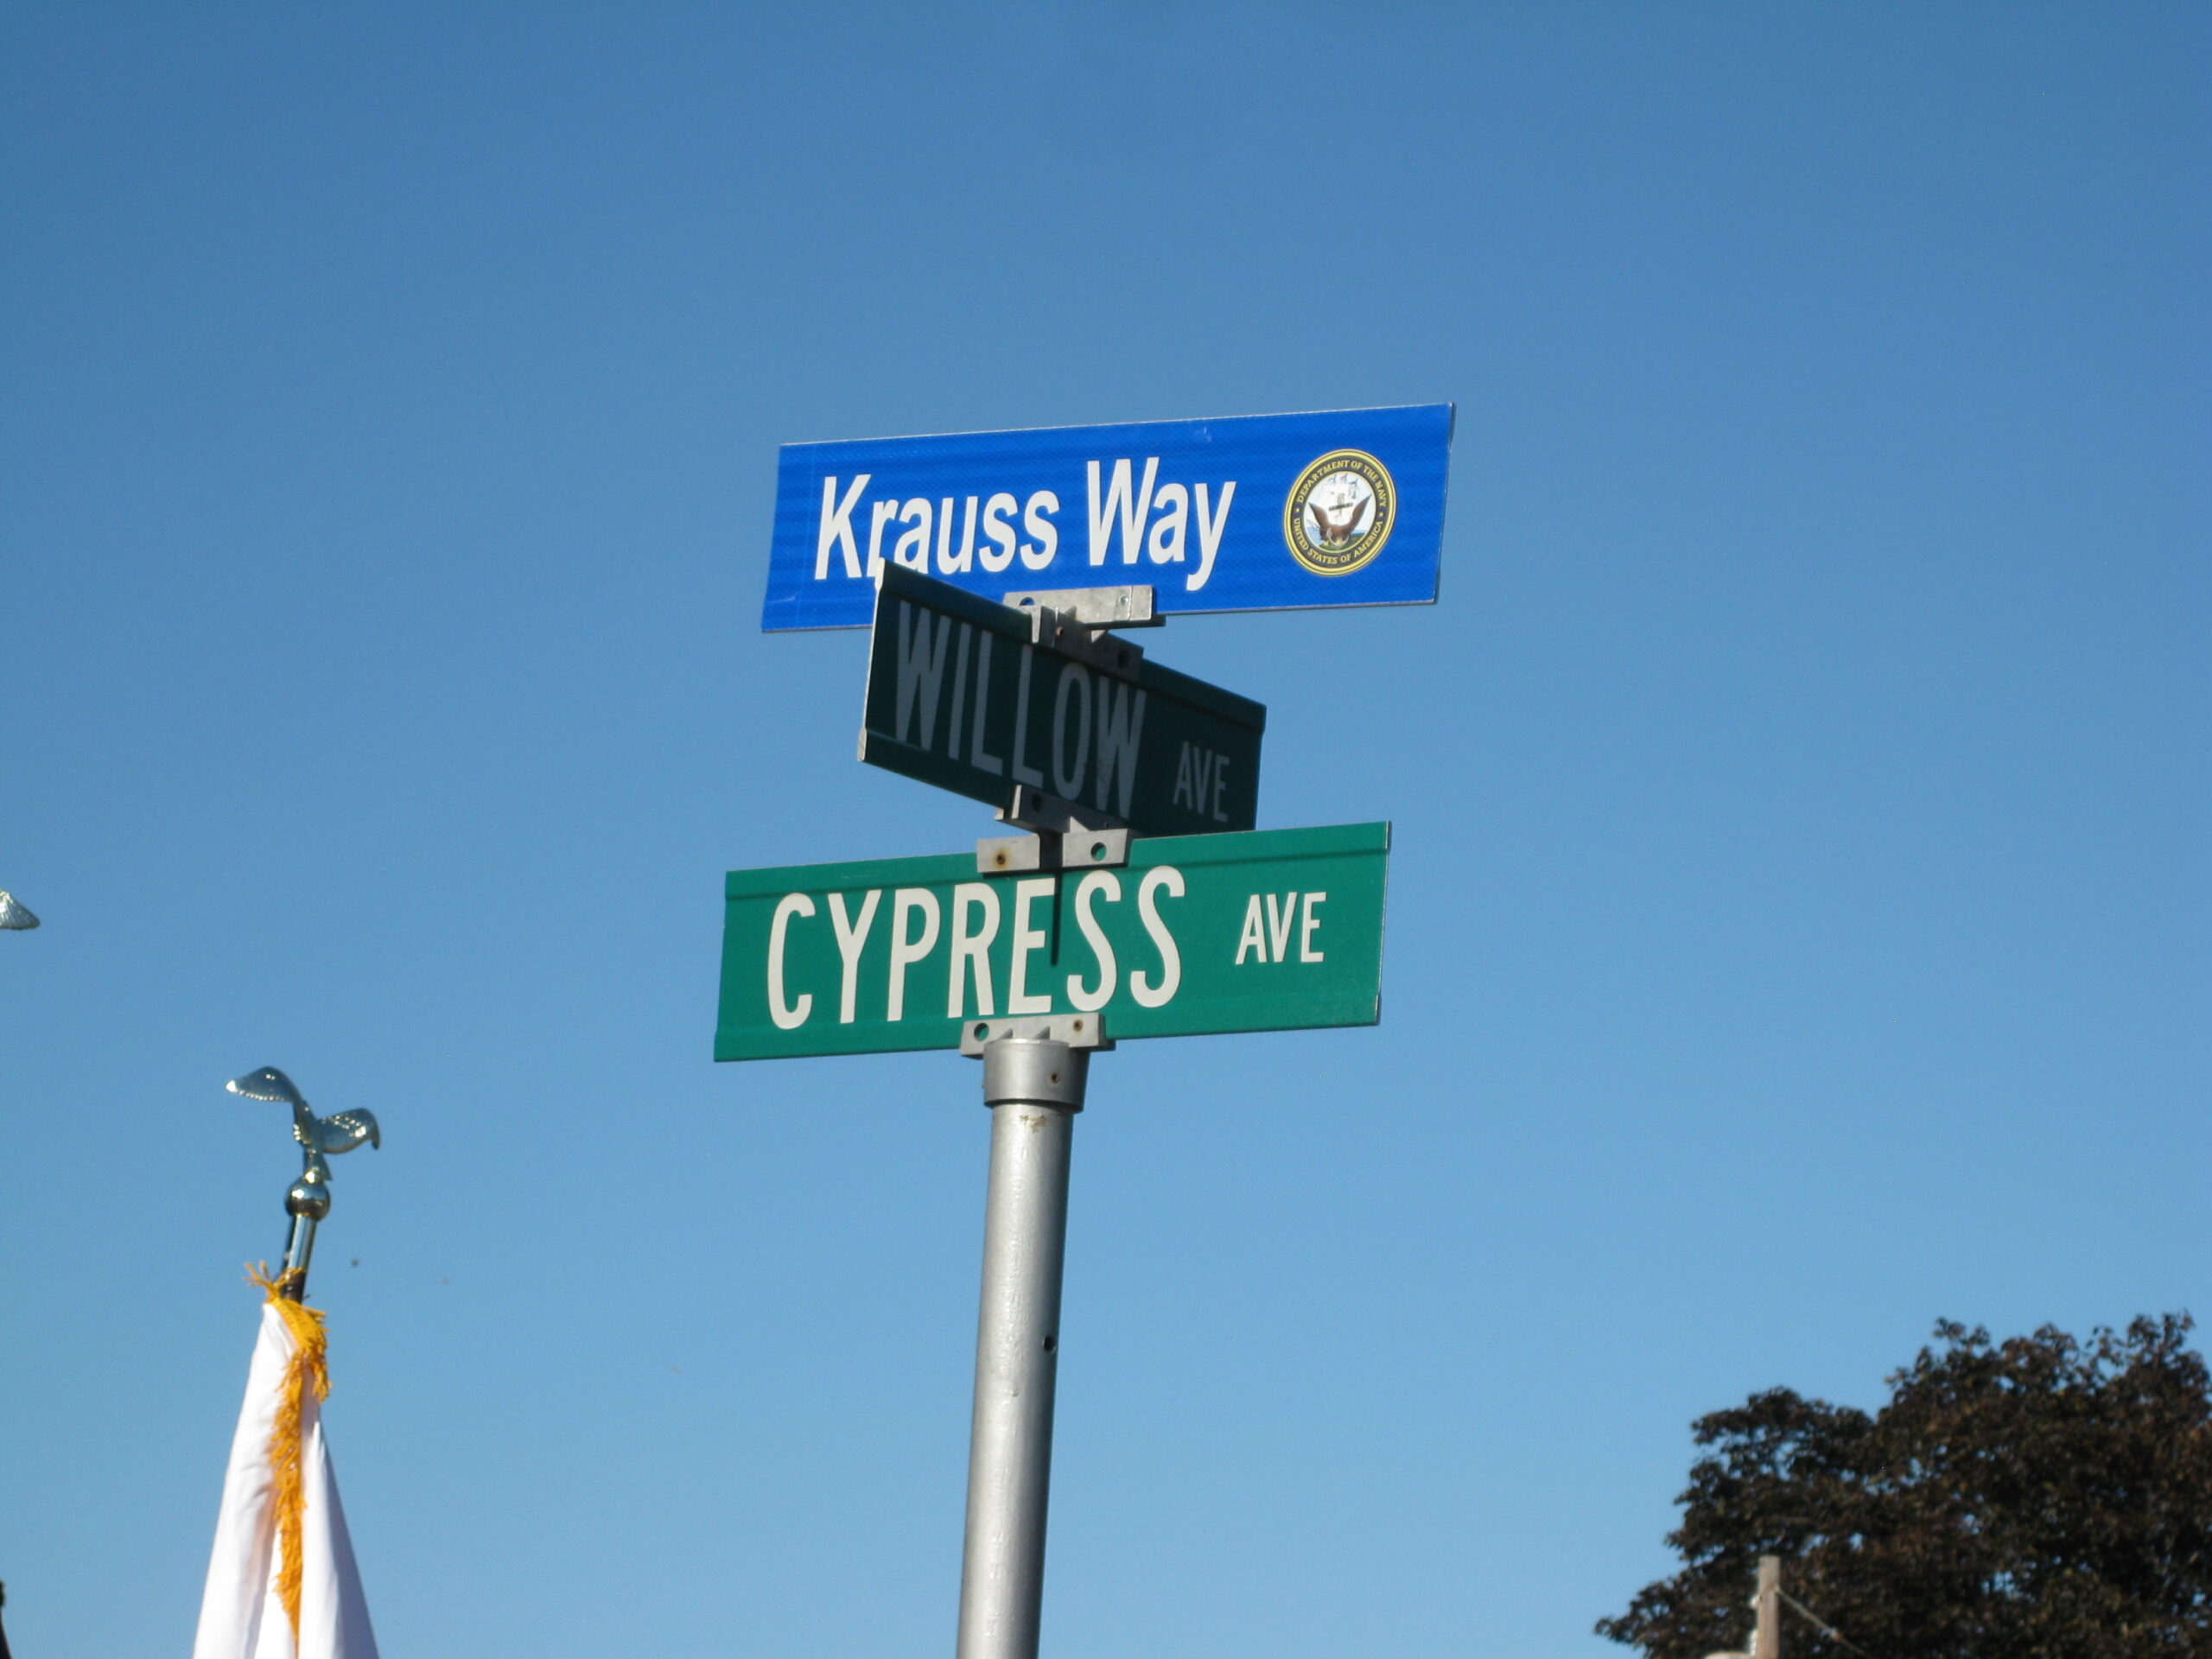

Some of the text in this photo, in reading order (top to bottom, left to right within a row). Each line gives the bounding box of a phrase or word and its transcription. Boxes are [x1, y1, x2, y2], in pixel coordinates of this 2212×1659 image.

[814, 455, 1237, 592] Krauss Way
[1294, 518, 1383, 565] UNITED STATES OF AMERICA
[1297, 460, 1388, 507] DEPARTMENT OF THE NAVY
[895, 600, 1230, 823] WILLOW AVE
[766, 865, 1327, 1030] CYPRESS AVE
